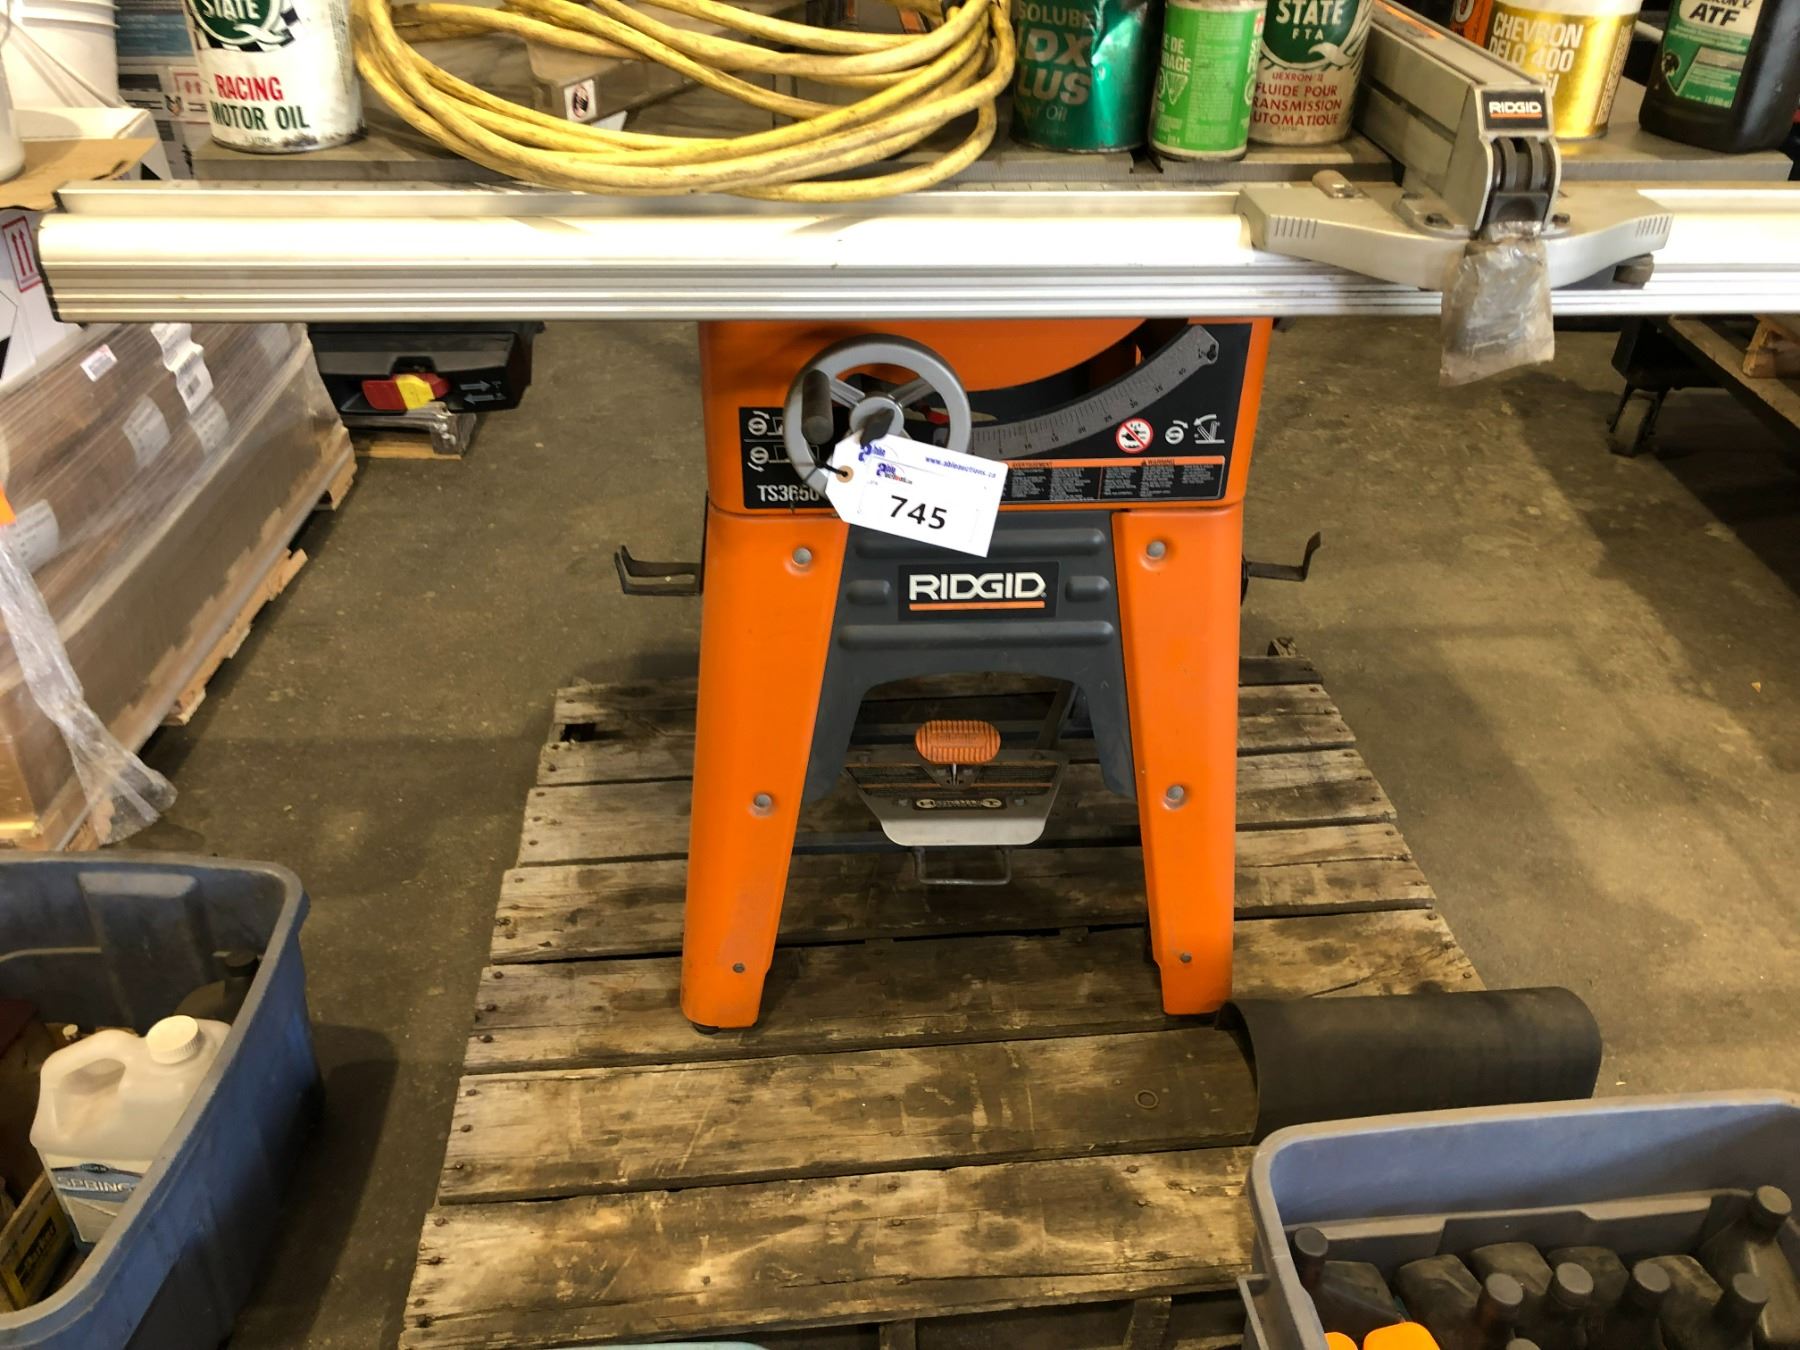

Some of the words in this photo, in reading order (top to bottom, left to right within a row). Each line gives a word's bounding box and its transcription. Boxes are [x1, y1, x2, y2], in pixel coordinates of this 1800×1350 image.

[1275, 0, 1344, 25] STATE
[1688, 3, 1740, 26] ATF
[1493, 12, 1584, 48] CHEVRON
[1531, 47, 1575, 72] 400
[214, 73, 284, 102] RACING
[1255, 82, 1298, 97] FLUIDE
[1304, 84, 1338, 98] POUR
[210, 101, 268, 130] MOTOR
[275, 105, 310, 130] OIL
[1252, 96, 1342, 112] RANSMISSION
[1488, 100, 1542, 114] RIDGID
[1250, 112, 1339, 127] UTOMATIQUE
[890, 494, 949, 531] 745
[909, 572, 1046, 601] RIDGID
